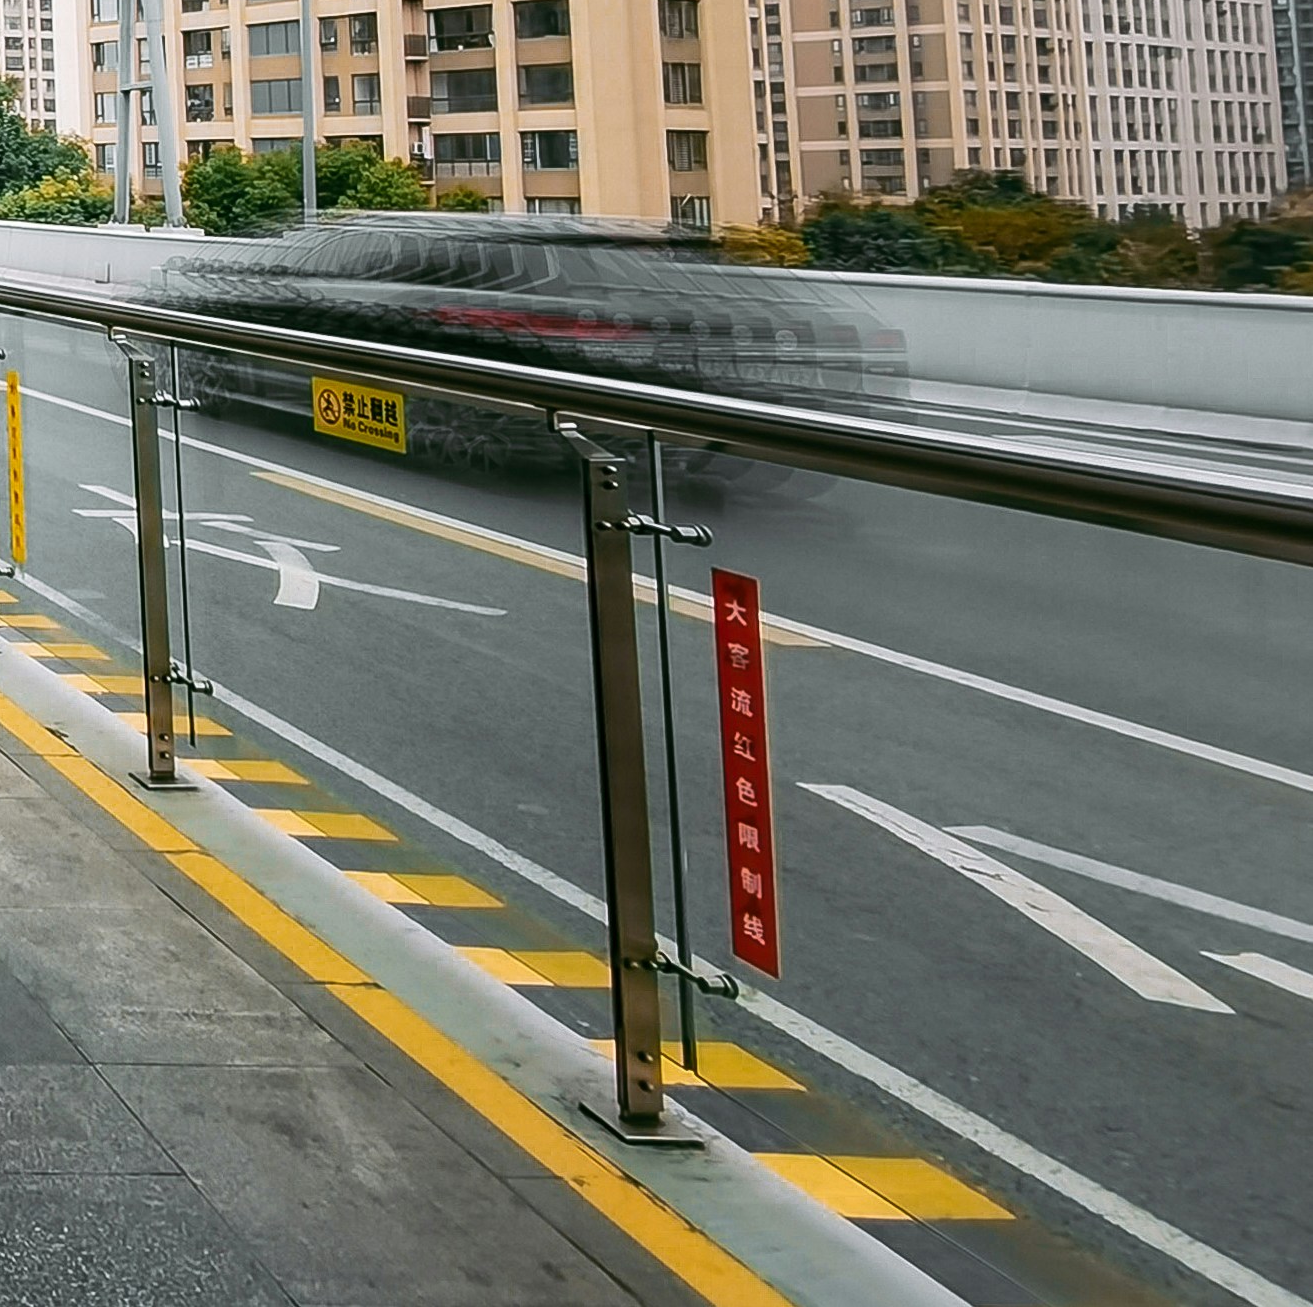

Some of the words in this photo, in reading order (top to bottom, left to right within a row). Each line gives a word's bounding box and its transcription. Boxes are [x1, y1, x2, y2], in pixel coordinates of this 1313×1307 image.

[342, 391, 399, 427] 禁止翻越
[343, 417, 357, 431] No
[358, 421, 400, 444] Crossing
[725, 599, 767, 946] 大客流红色限制线
